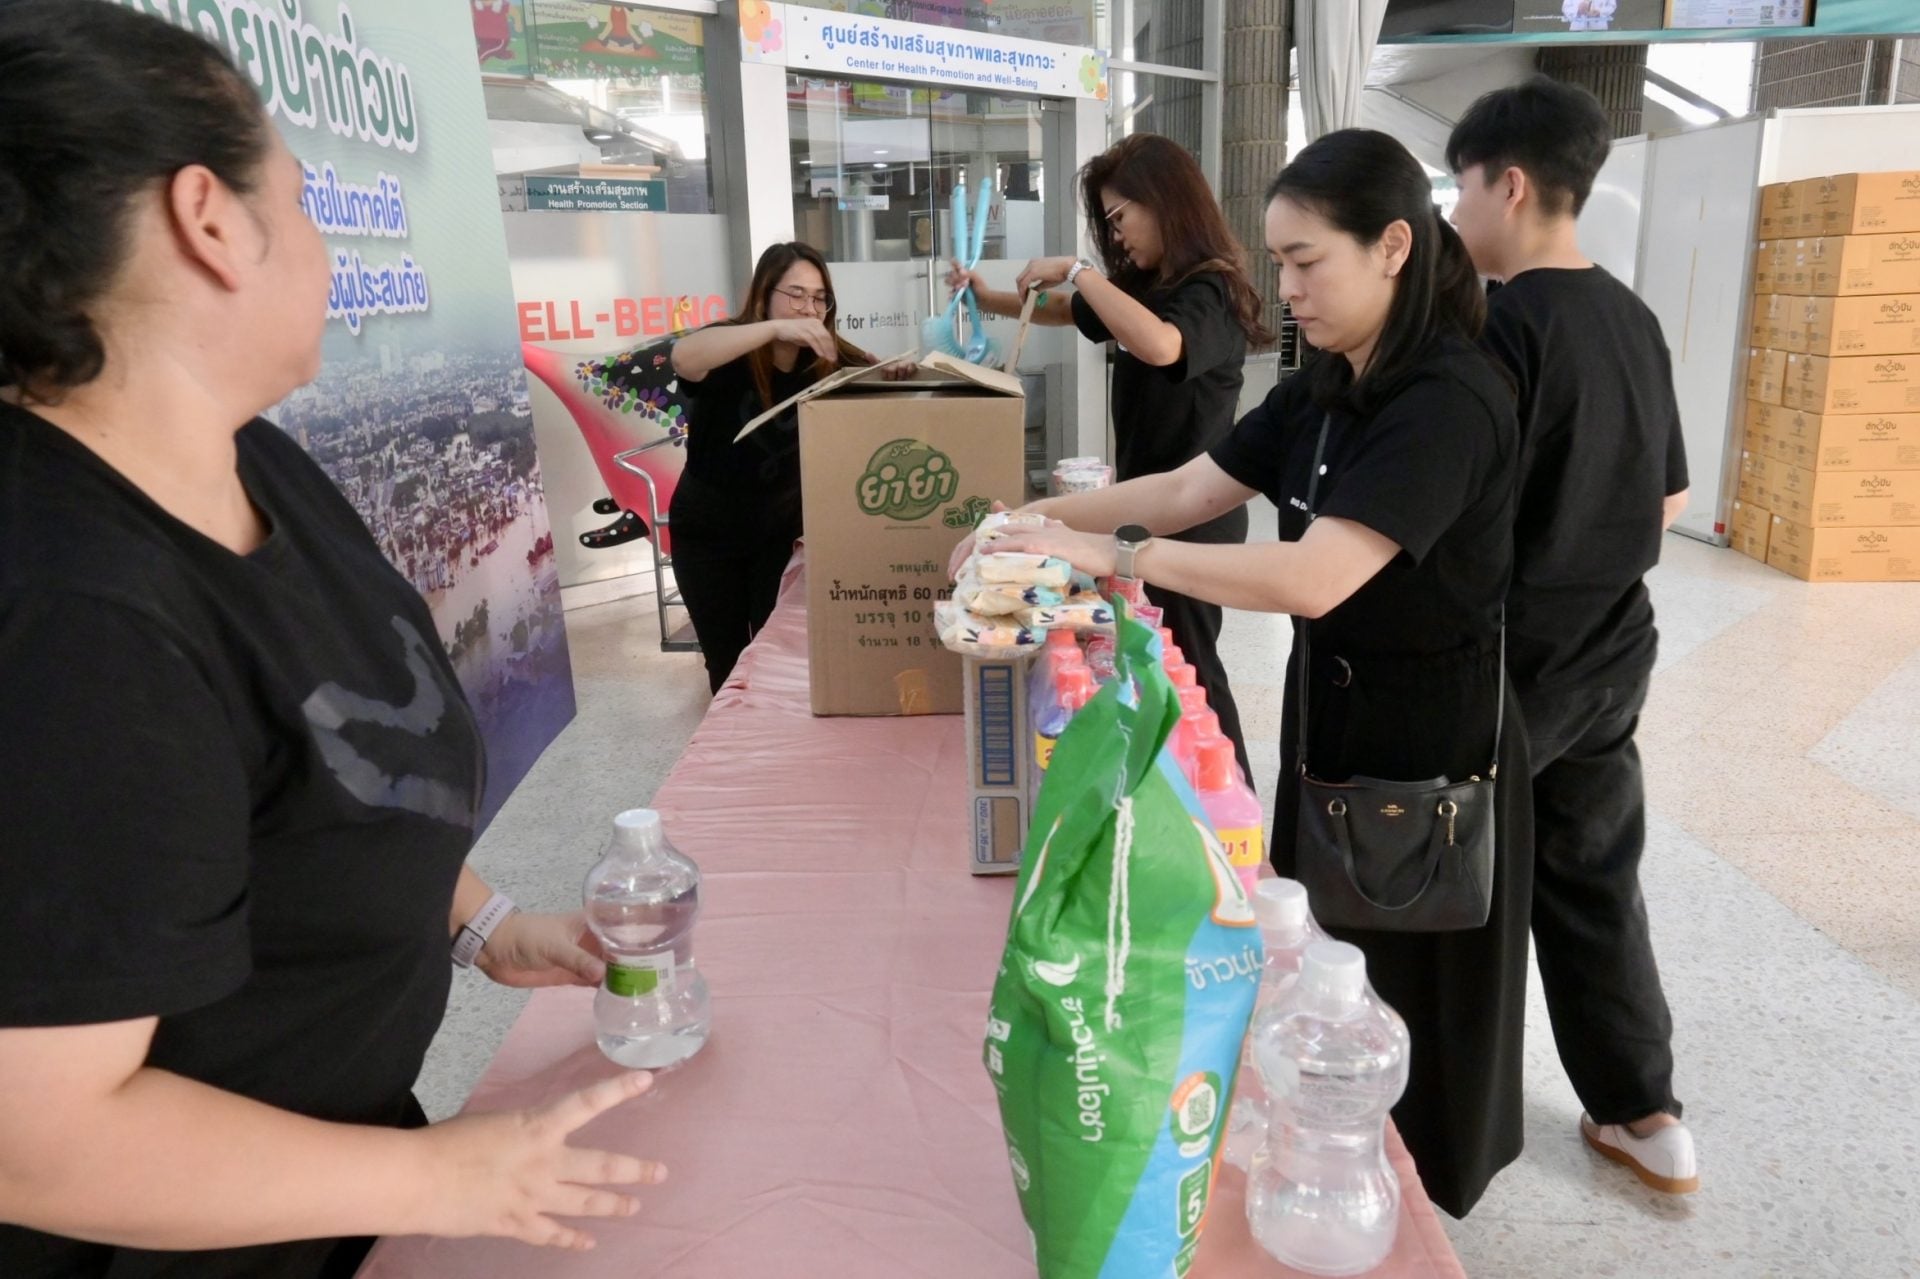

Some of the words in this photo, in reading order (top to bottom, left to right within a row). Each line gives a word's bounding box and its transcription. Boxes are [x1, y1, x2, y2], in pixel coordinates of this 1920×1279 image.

[822, 23, 1056, 72] ศูนย์สร้างเสริมสุขภาพและสุขภาวะ
[846, 56, 879, 70] Center
[882, 60, 895, 71] for
[898, 62, 928, 75] Health
[930, 66, 974, 81] Promotion
[977, 73, 992, 83] and
[994, 74, 1038, 90] Well-Being
[549, 181, 648, 201] งานสร้างเสริมสุขภาพ
[549, 199, 574, 209] Health
[577, 200, 617, 209] Promotion
[620, 201, 648, 209] Section
[517, 294, 728, 341] ELL-BEING
[846, 314, 865, 330] for
[858, 453, 955, 512] ยำยำ
[889, 560, 938, 576] รสหมูสับ
[829, 579, 908, 607] น้ำหนักสุทธิ
[913, 586, 931, 600] 60
[937, 582, 957, 600] กรั
[855, 611, 896, 628] บรรจุ
[904, 610, 921, 623] 10
[858, 635, 898, 648] จำนวน
[906, 636, 921, 647] 18
[1187, 1187, 1203, 1225] 5
